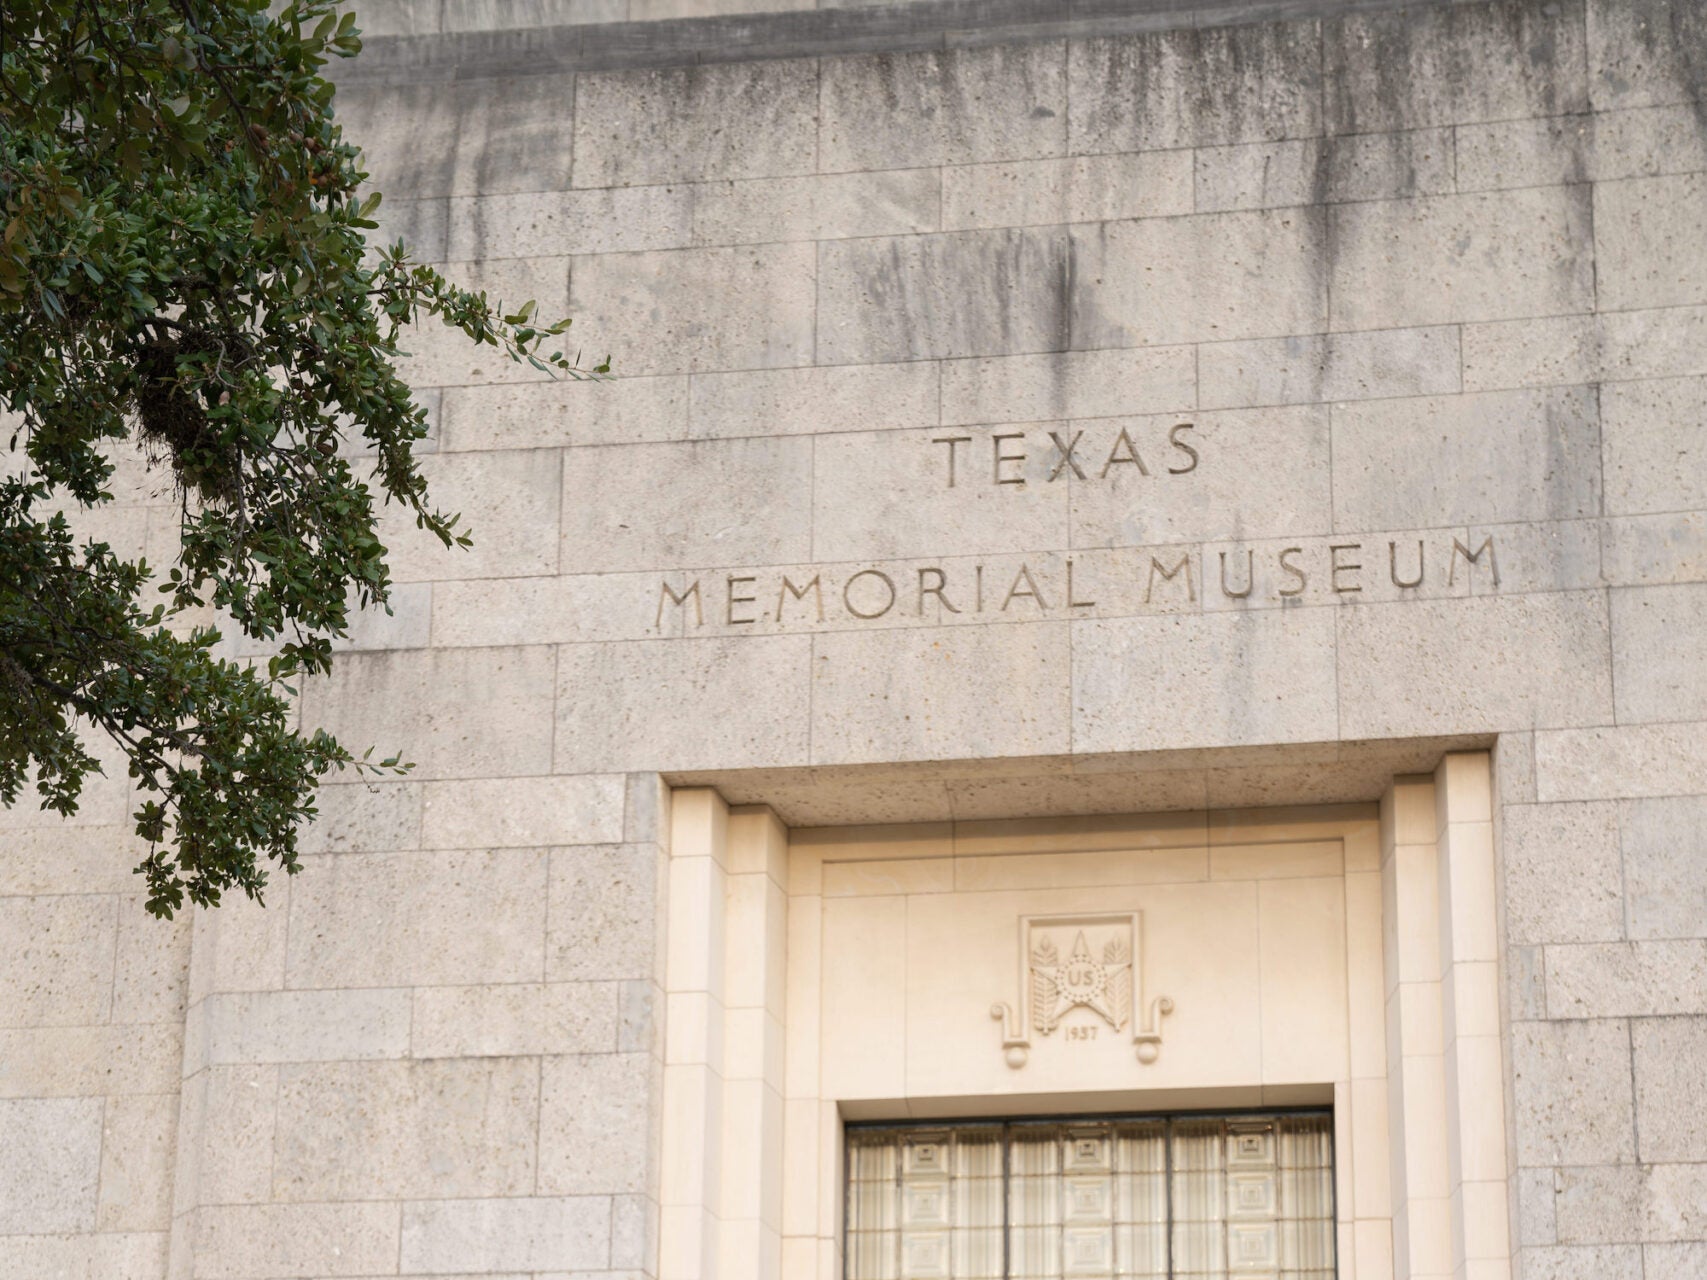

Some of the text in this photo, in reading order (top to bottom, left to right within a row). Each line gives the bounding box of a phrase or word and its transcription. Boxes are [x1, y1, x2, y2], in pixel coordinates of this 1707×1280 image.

[932, 424, 1201, 487] TEXAS
[656, 536, 1502, 628] MEMORIAL MUSEUM
[1069, 970, 1094, 986] US
